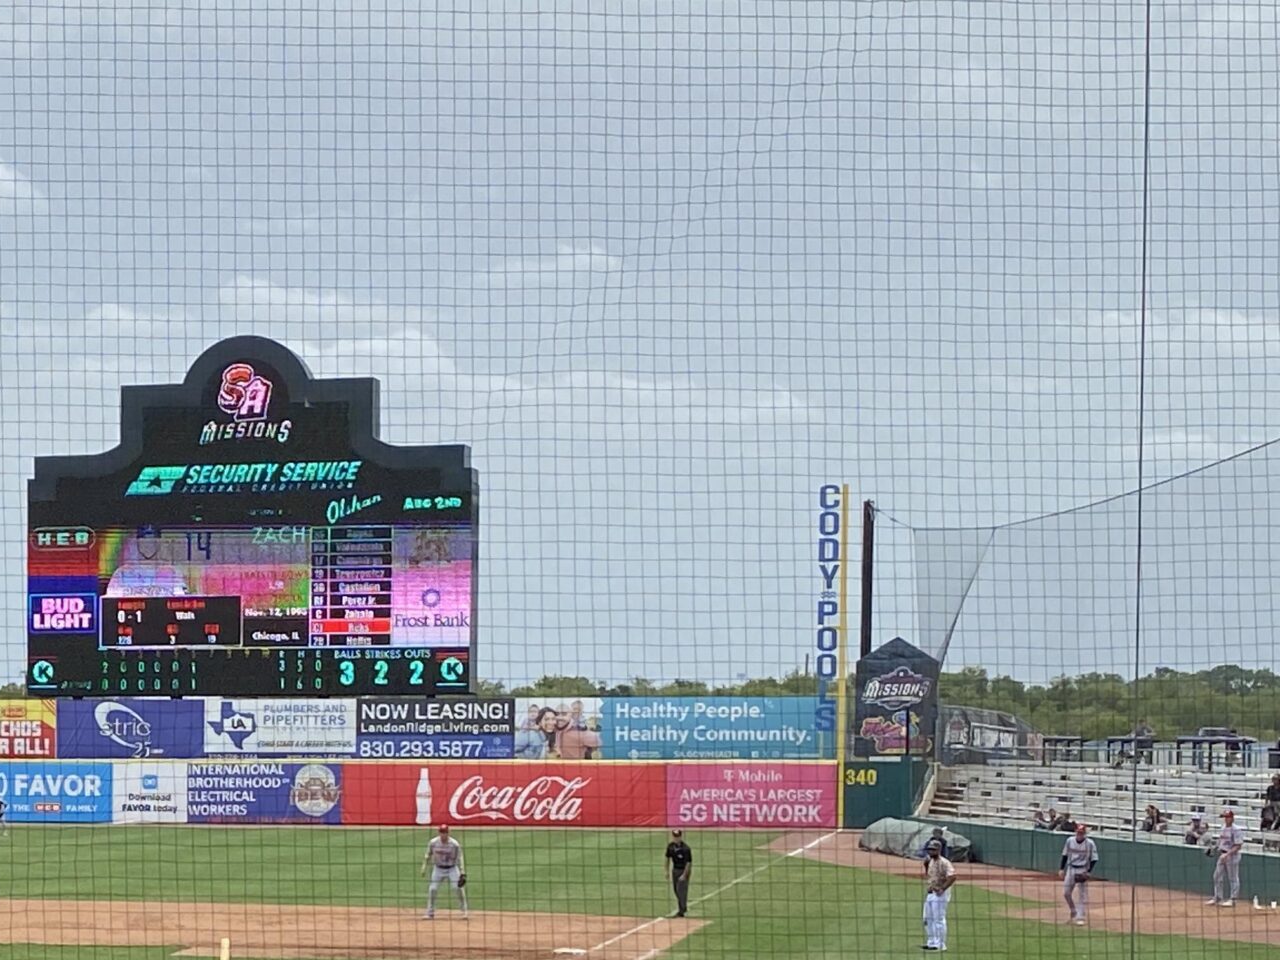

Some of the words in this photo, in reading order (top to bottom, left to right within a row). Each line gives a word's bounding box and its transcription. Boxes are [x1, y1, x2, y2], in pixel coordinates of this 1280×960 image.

[218, 363, 272, 421] SA
[199, 420, 292, 445] MISSIONS
[186, 463, 279, 485] SECURITY
[280, 460, 362, 483] SERVICE
[326, 494, 382, 524] Olshan
[251, 527, 306, 544] ZACH
[818, 484, 840, 589] CODY
[185, 531, 211, 561] 14
[41, 598, 84, 614] BUD
[33, 613, 91, 630] LIGHT
[394, 613, 430, 628] Frost
[434, 612, 470, 628] Bank
[252, 631, 289, 643] Chicago,
[334, 650, 361, 659] BALLS
[365, 650, 402, 659] STRIKES
[404, 649, 431, 659] OUTS
[297, 660, 303, 672] 5
[315, 660, 322, 672] 0
[339, 660, 355, 685] 3
[374, 660, 389, 685] 2
[409, 660, 424, 685] 2
[815, 600, 839, 731] POOLS
[315, 678, 322, 690] 0
[863, 680, 930, 698] MISSIONS
[263, 704, 320, 714] PLUMBERS
[325, 704, 347, 713] AND
[361, 703, 408, 720] NOW
[415, 702, 509, 720] LEASING!
[615, 702, 690, 722] Healthy
[693, 702, 765, 722] People.
[263, 714, 347, 726] PIPEFITTERS
[615, 725, 689, 745] Healthy
[693, 725, 812, 745] Community.
[14, 737, 50, 755] ALL!
[359, 740, 483, 758] 830.293.5877
[187, 763, 285, 775] INTERNATIONAL
[738, 769, 783, 782] Mobile
[845, 769, 877, 785] 340
[14, 773, 101, 797] FAVOR
[187, 777, 281, 788] BROTHERHOOD
[128, 793, 172, 802] Download
[187, 790, 256, 802] ELECTRICAL
[680, 789, 756, 802] AMERICA'S
[760, 789, 823, 802] LARGEST
[12, 804, 30, 812] THE
[66, 804, 99, 812] FAMILY
[122, 804, 151, 813] FAVOR
[153, 804, 178, 814] today
[187, 804, 248, 816] WORKERS
[678, 804, 708, 822] 5G
[712, 803, 822, 822] NETWORK
